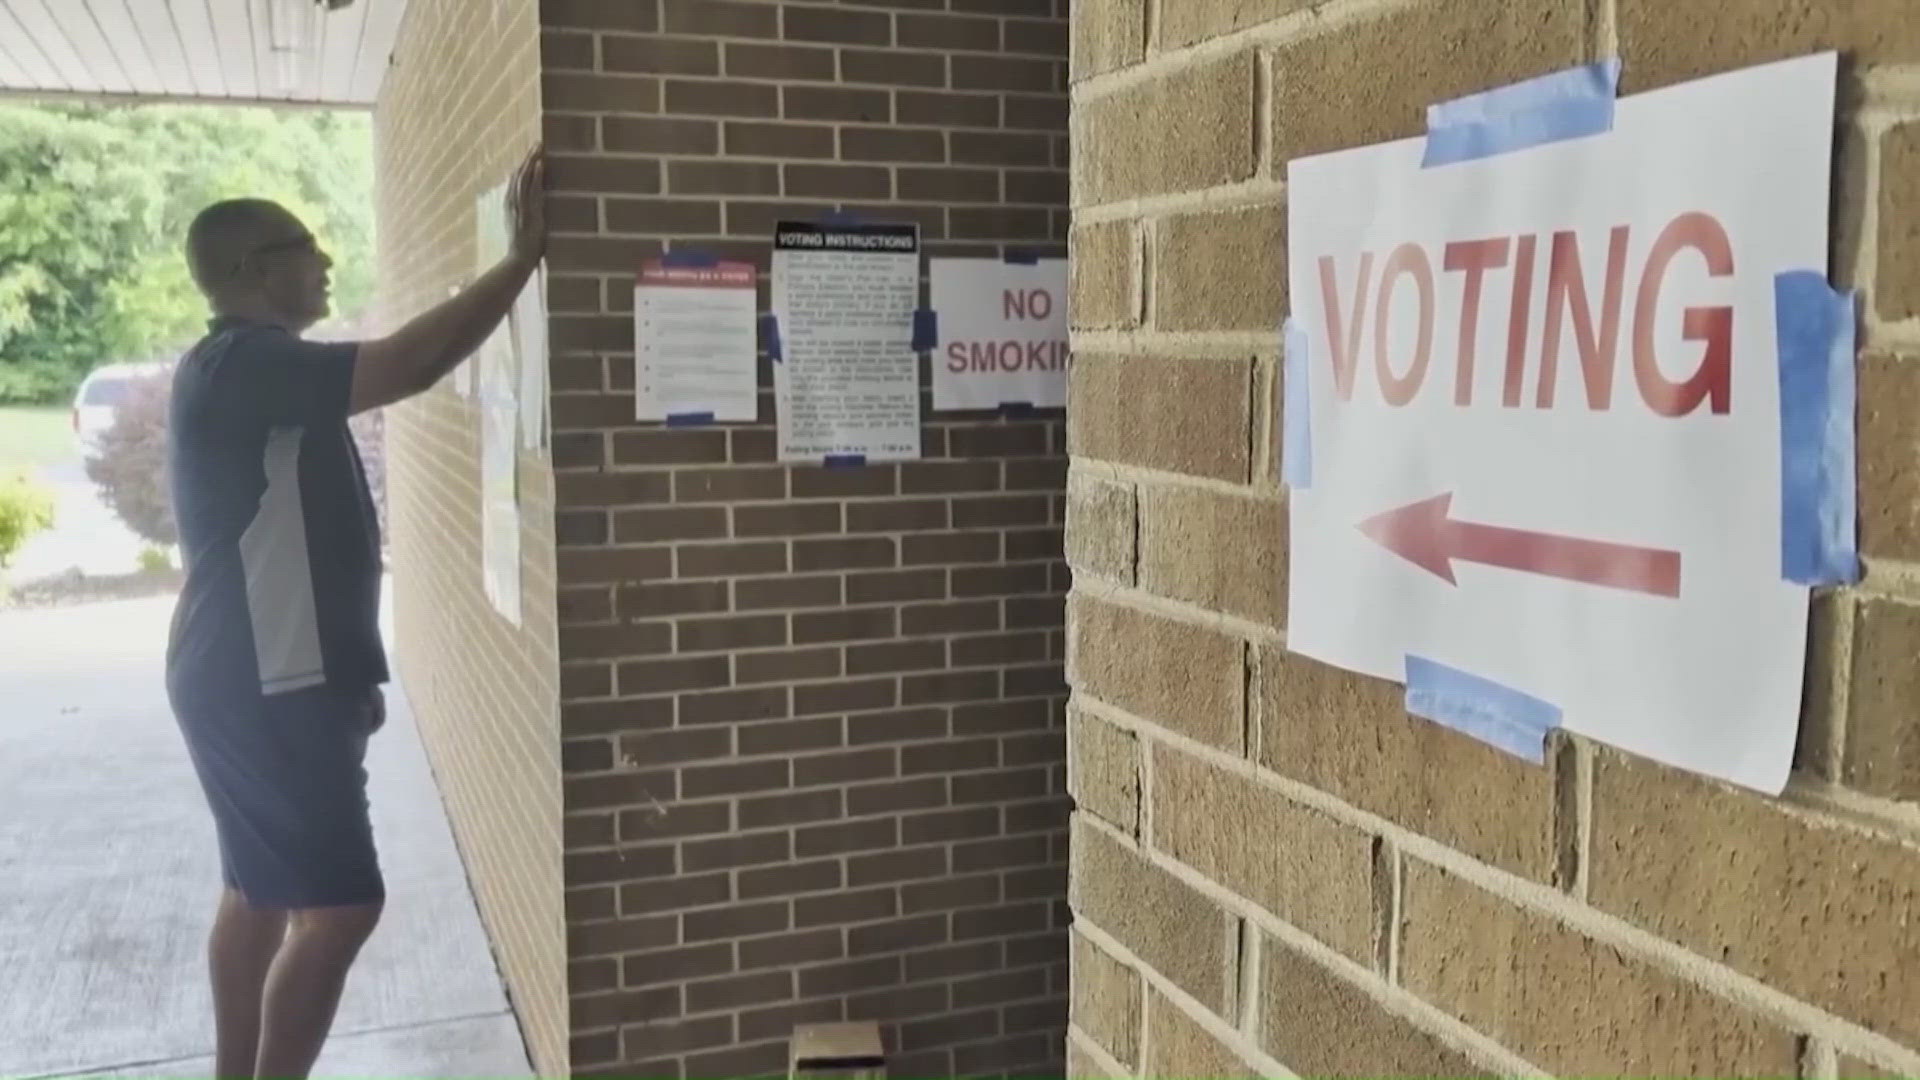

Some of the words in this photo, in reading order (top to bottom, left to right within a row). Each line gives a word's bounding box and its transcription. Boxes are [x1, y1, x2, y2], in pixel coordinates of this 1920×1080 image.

[779, 232, 822, 247] VOTING
[825, 233, 913, 249] INSTRUCTIONS
[1004, 289, 1051, 320] NO
[1318, 211, 1734, 417] VOTING
